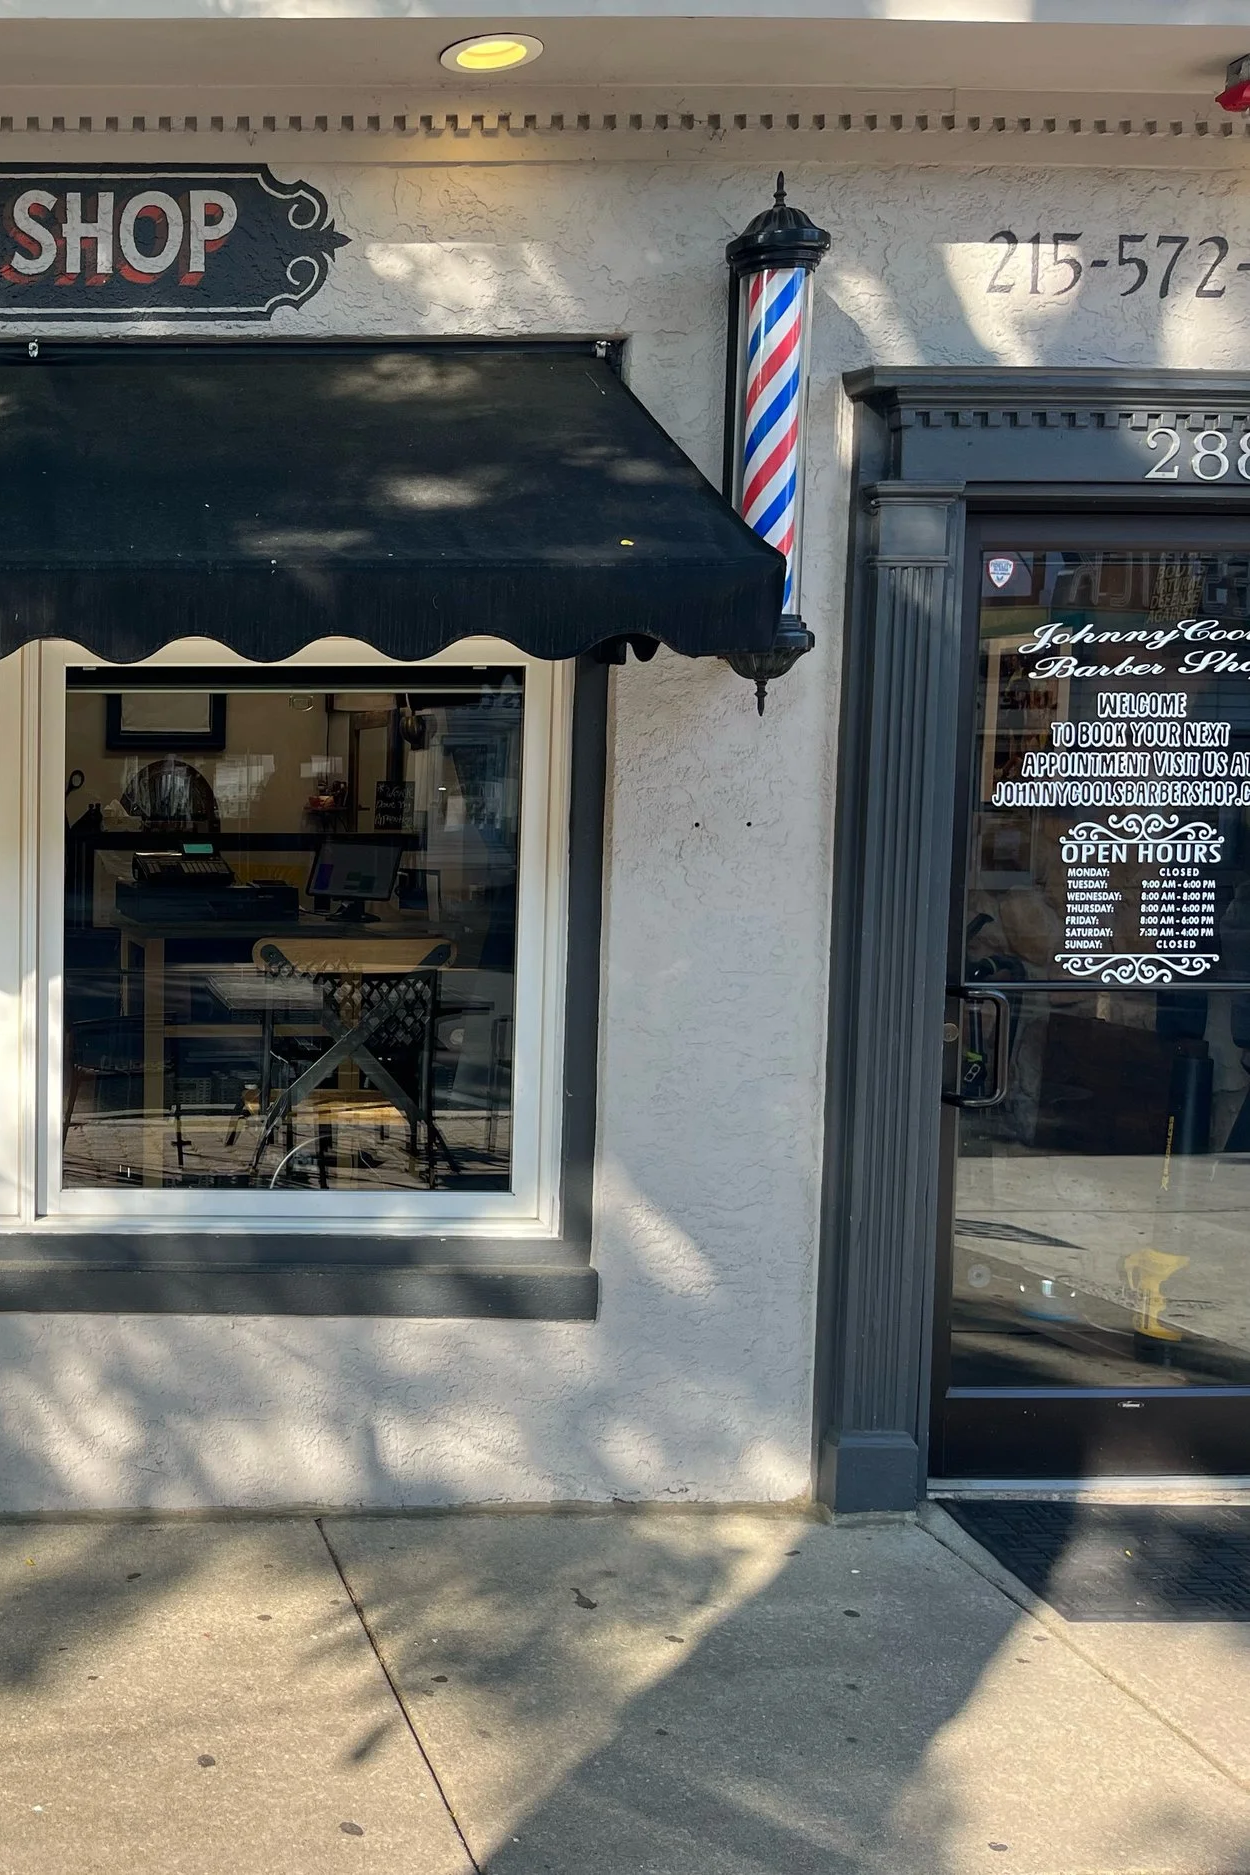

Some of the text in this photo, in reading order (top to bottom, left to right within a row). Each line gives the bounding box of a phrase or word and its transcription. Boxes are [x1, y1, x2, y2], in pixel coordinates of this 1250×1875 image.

[10, 189, 239, 277] SHOP
[1018, 619, 1250, 654] Johnny Coo
[1028, 650, 1250, 680] Barber Sho
[1097, 692, 1187, 718] WELCOME
[1051, 722, 1230, 747] TO BOOK YOUR NEXT
[1021, 752, 1151, 777] APPOINTMENT
[1152, 752, 1200, 777] VISIT
[1202, 752, 1228, 777] US
[1061, 844, 1222, 863] OPEN HOURS
[1067, 867, 1200, 877] MONDAY: CLOSED
[1067, 879, 1108, 889] TUESDAY:
[1141, 880, 1160, 889] 9:00
[1161, 880, 1176, 889] AM
[1182, 880, 1201, 889] 6:00
[1202, 880, 1216, 889] PM
[1066, 891, 1122, 901] WEDNESDAY:
[1141, 892, 1159, 901] 8:00
[1161, 892, 1176, 901] AM
[1182, 892, 1201, 901] 8:00
[1202, 892, 1215, 901] PM
[1066, 903, 1114, 913] THURSDAY:
[1140, 904, 1159, 913] 8:00
[1160, 904, 1175, 913] AM
[1181, 904, 1200, 913] 6:00
[1201, 904, 1215, 913] PM
[1065, 915, 1099, 925] FRIDAY:
[1140, 916, 1158, 925] 8:00
[1160, 916, 1174, 925] AM
[1181, 916, 1200, 925] 6:00
[1200, 916, 1214, 925] PM
[1065, 927, 1113, 937] SATURDAY:
[1139, 928, 1158, 937] 7:30
[1159, 928, 1174, 937] AM
[1180, 928, 1199, 937] 4:00
[1200, 928, 1214, 937] PM
[1064, 939, 1197, 949] SUNDAY: CLOSED
